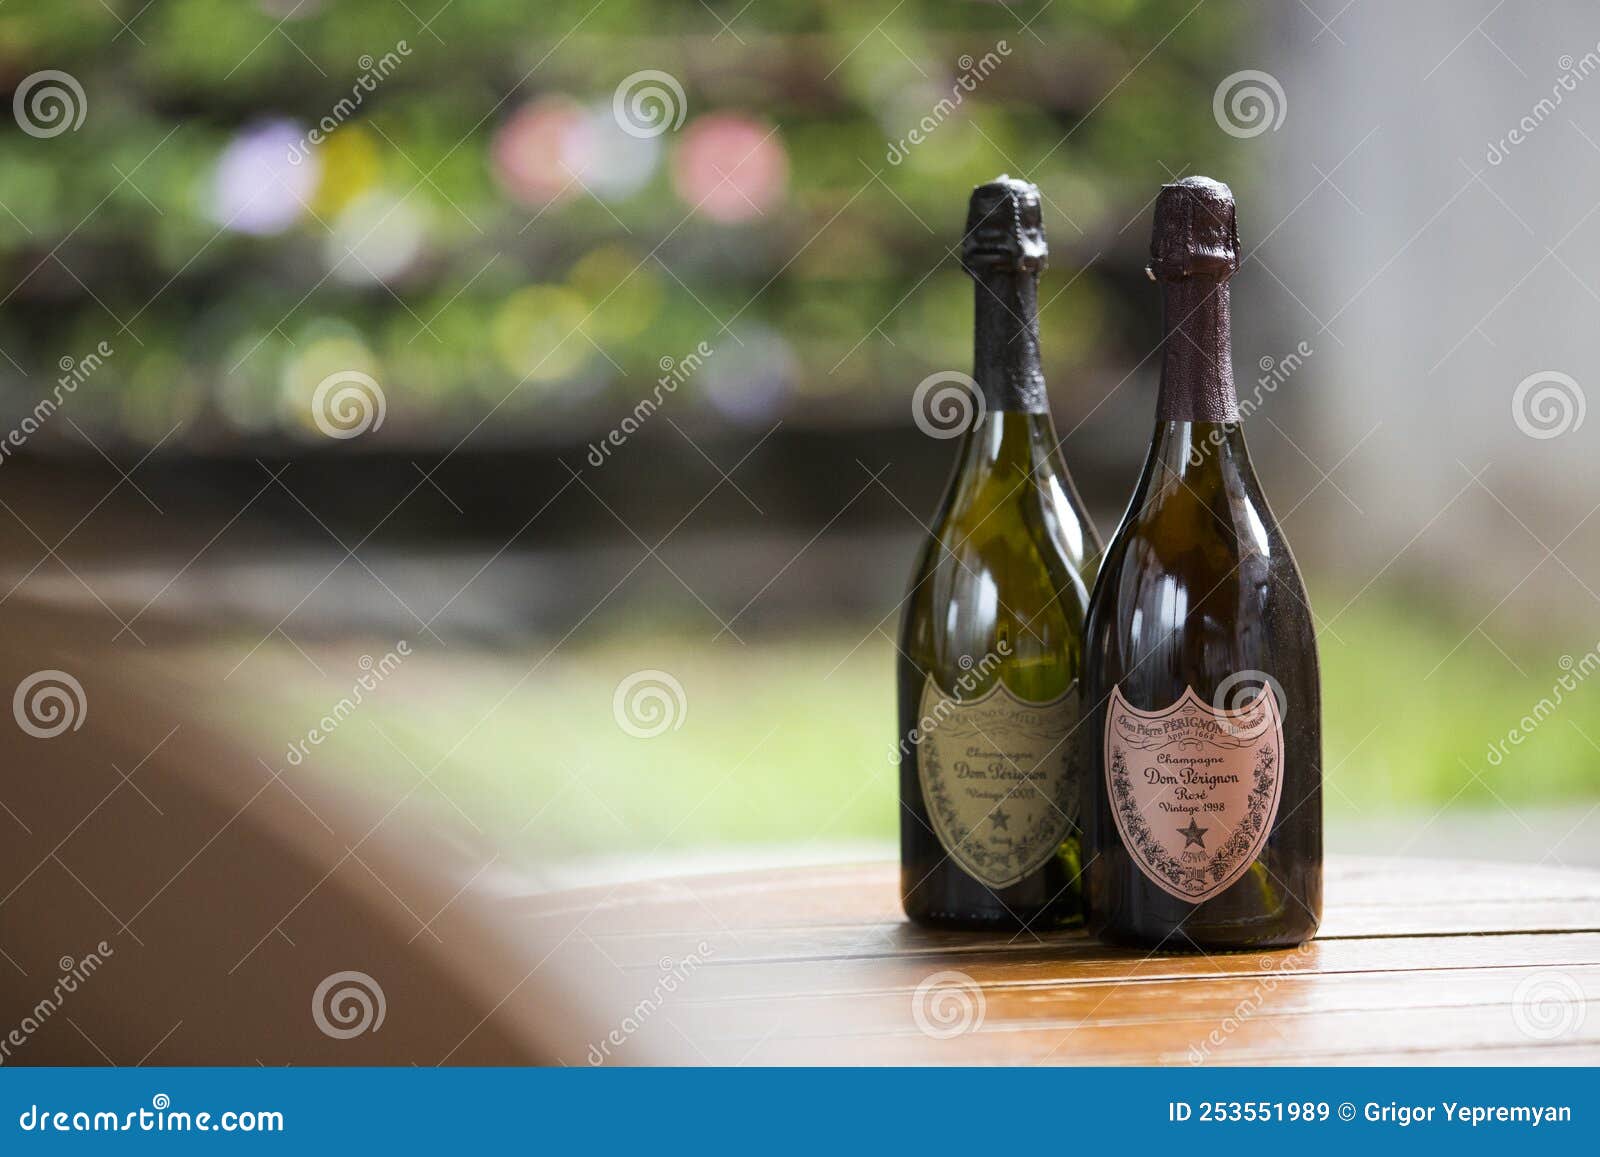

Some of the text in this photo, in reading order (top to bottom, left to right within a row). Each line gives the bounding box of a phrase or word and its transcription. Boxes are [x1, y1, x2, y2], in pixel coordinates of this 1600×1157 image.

[1117, 714, 1136, 732] Dom
[1136, 724, 1164, 737] Pierre
[1163, 716, 1223, 735] PÉRIGNON
[1156, 753, 1225, 767] Champagne
[953, 761, 987, 779] Dom
[1143, 768, 1240, 790] Dom Pérignon
[1174, 787, 1209, 801] Rosé
[1158, 802, 1226, 816] Vintage 1998
